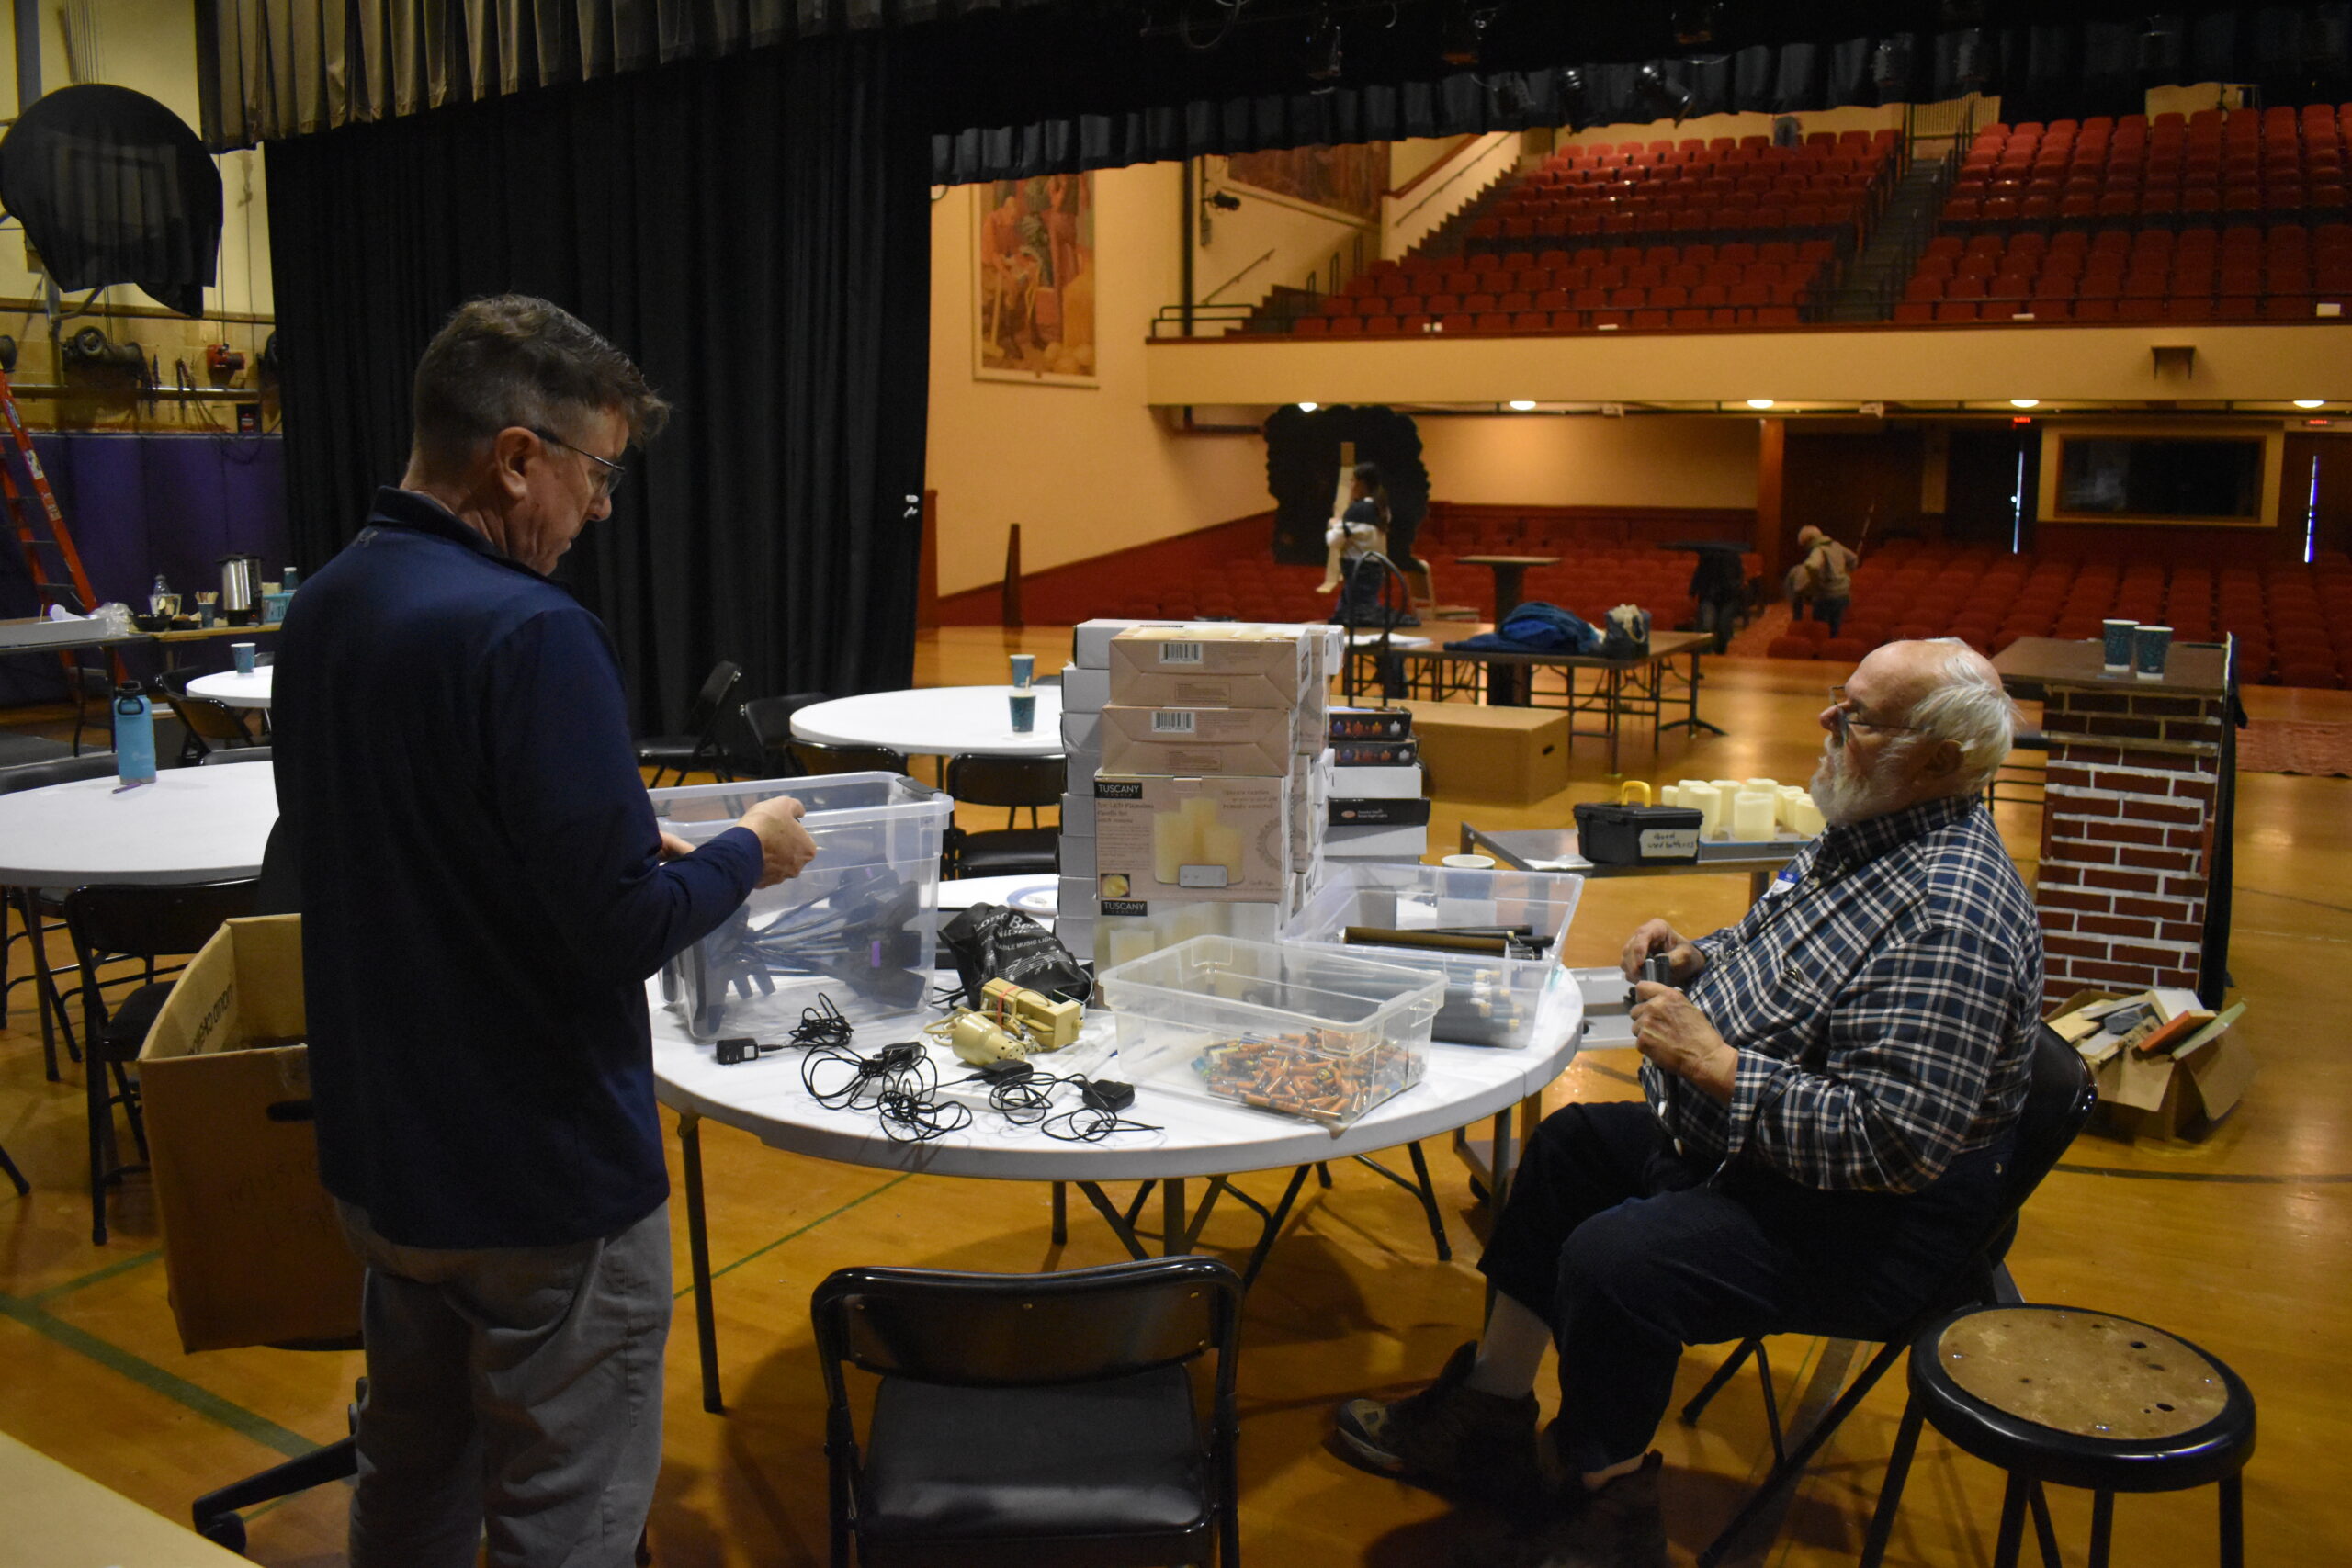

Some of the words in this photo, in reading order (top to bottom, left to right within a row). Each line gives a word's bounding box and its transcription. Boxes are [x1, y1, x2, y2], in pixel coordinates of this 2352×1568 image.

[1098, 784, 1139, 793] TUSCANY
[1104, 902, 1145, 910] TUSCANY
[1016, 939, 1037, 948] MUSIC
